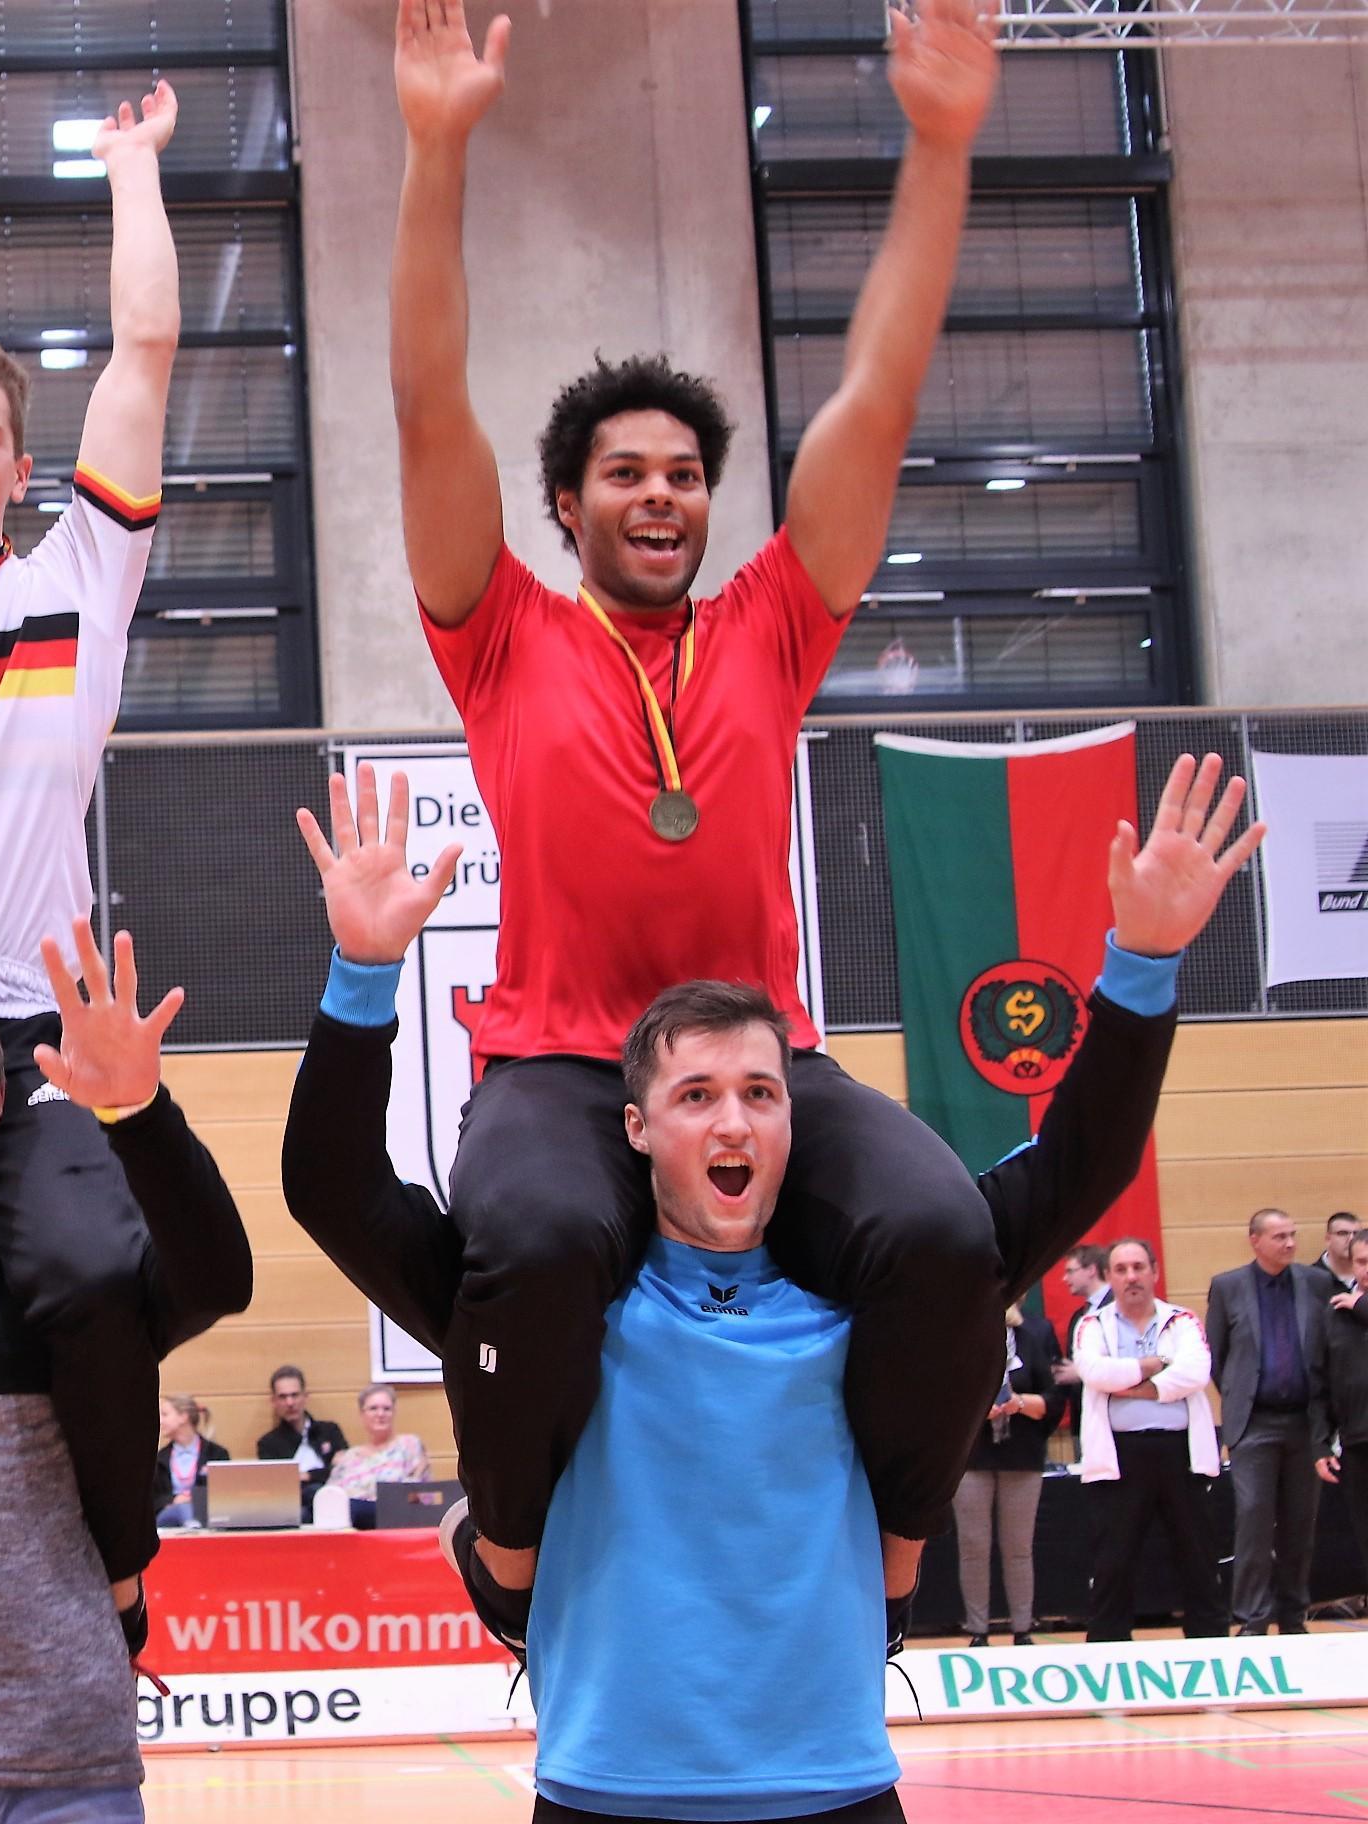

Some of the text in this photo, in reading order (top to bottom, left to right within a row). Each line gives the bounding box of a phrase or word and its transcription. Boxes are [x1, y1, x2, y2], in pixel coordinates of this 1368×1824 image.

[416, 792, 480, 828] Die
[700, 1304, 749, 1316] erima
[938, 1653, 1303, 1708] PROVINZIAL
[137, 1687, 361, 1740] gruppe
